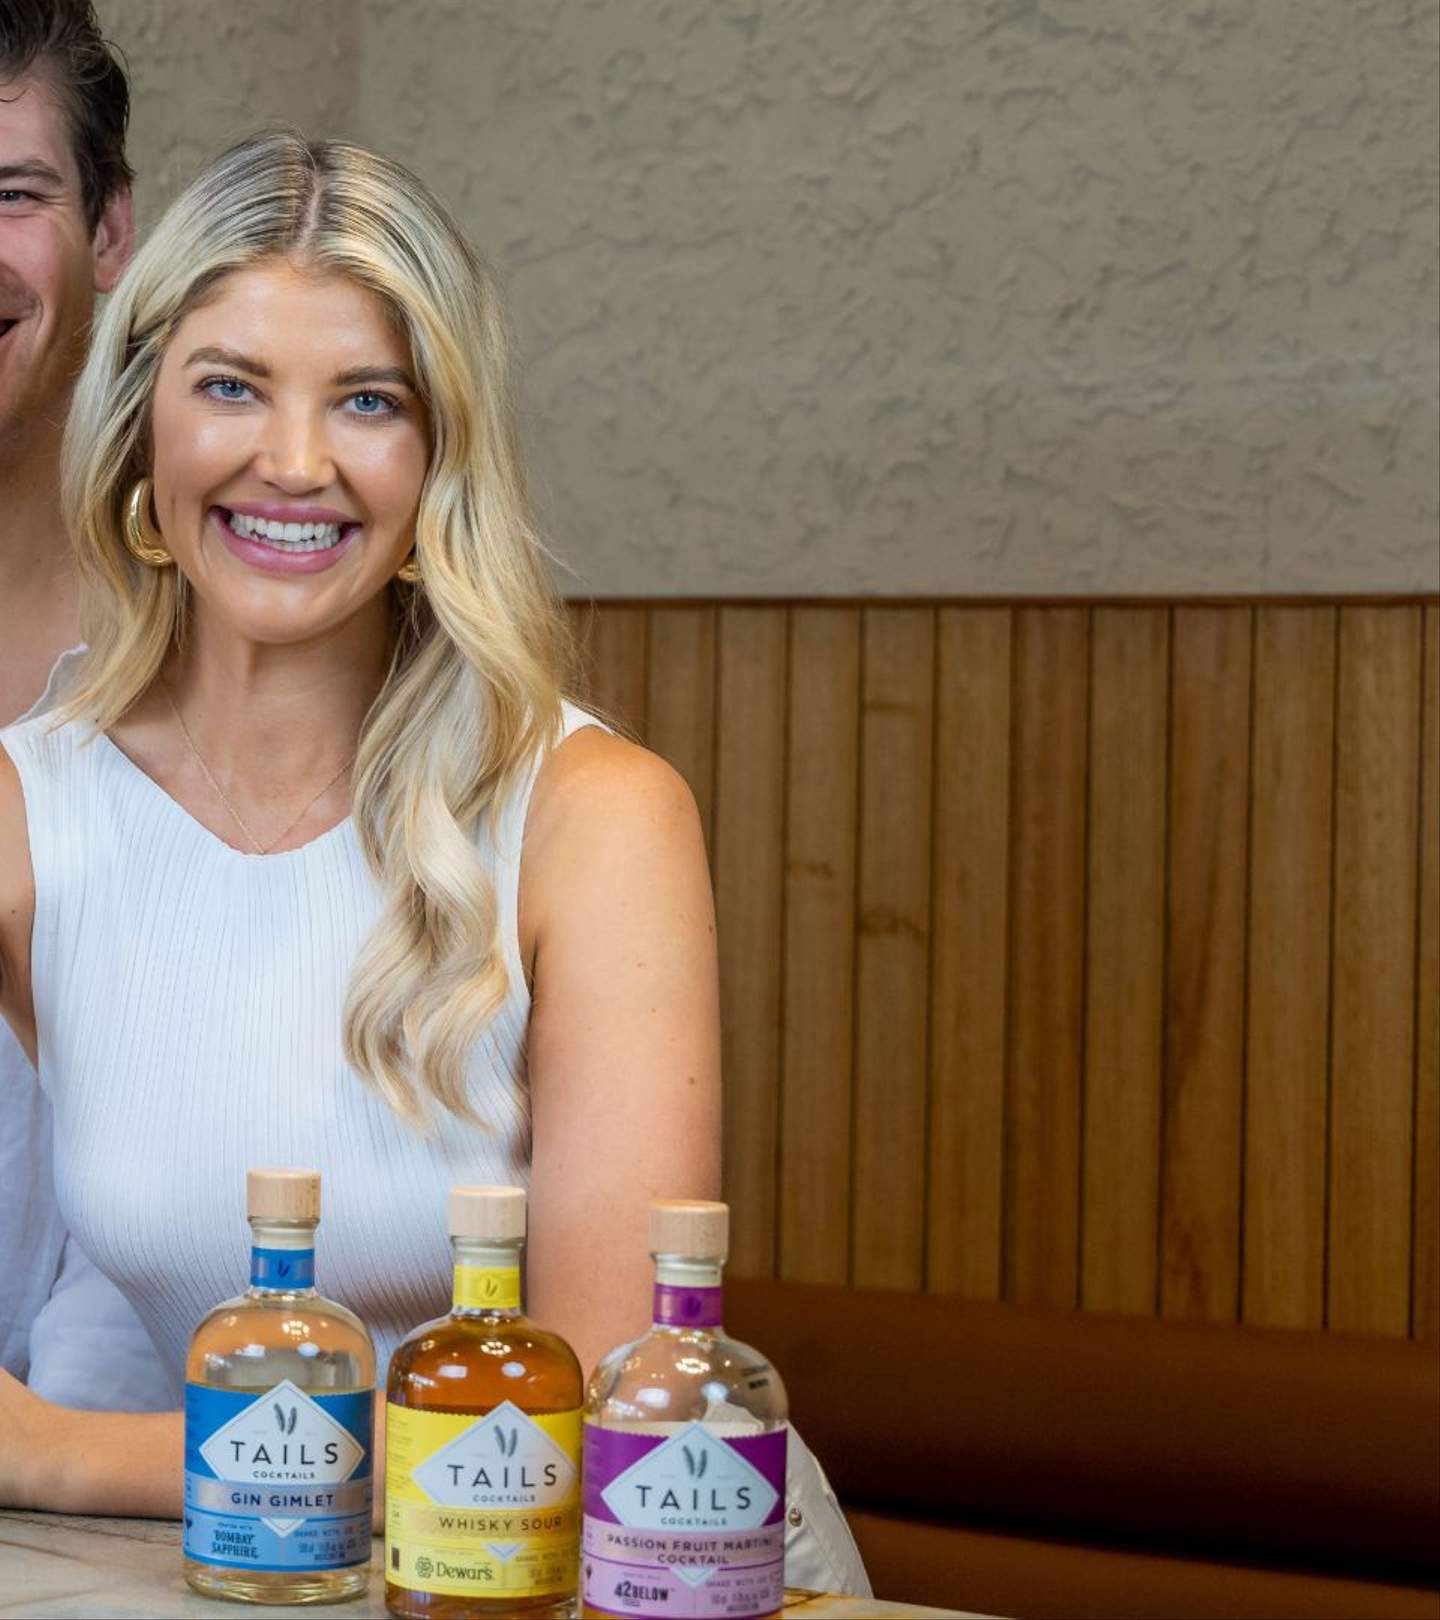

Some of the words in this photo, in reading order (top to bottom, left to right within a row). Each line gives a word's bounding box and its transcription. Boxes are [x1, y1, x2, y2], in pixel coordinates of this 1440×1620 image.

[230, 1440, 339, 1465] TAILS
[252, 1470, 316, 1480] COCKTAILS
[447, 1464, 557, 1488] TAILS
[231, 1492, 261, 1506] GIN
[269, 1494, 335, 1507] GIMLET
[472, 1494, 536, 1503] COCKTAILS
[635, 1485, 752, 1511] TAILS
[439, 1516, 513, 1531] WHISKY
[521, 1516, 562, 1531] SOUR
[661, 1517, 728, 1526] COCKTAILS
[214, 1530, 256, 1545] BOMBAY
[607, 1534, 666, 1551] PASSION
[672, 1540, 717, 1551] FRUIT
[212, 1542, 260, 1560] SAPPHIRE
[657, 1554, 729, 1566] COCKTAIL
